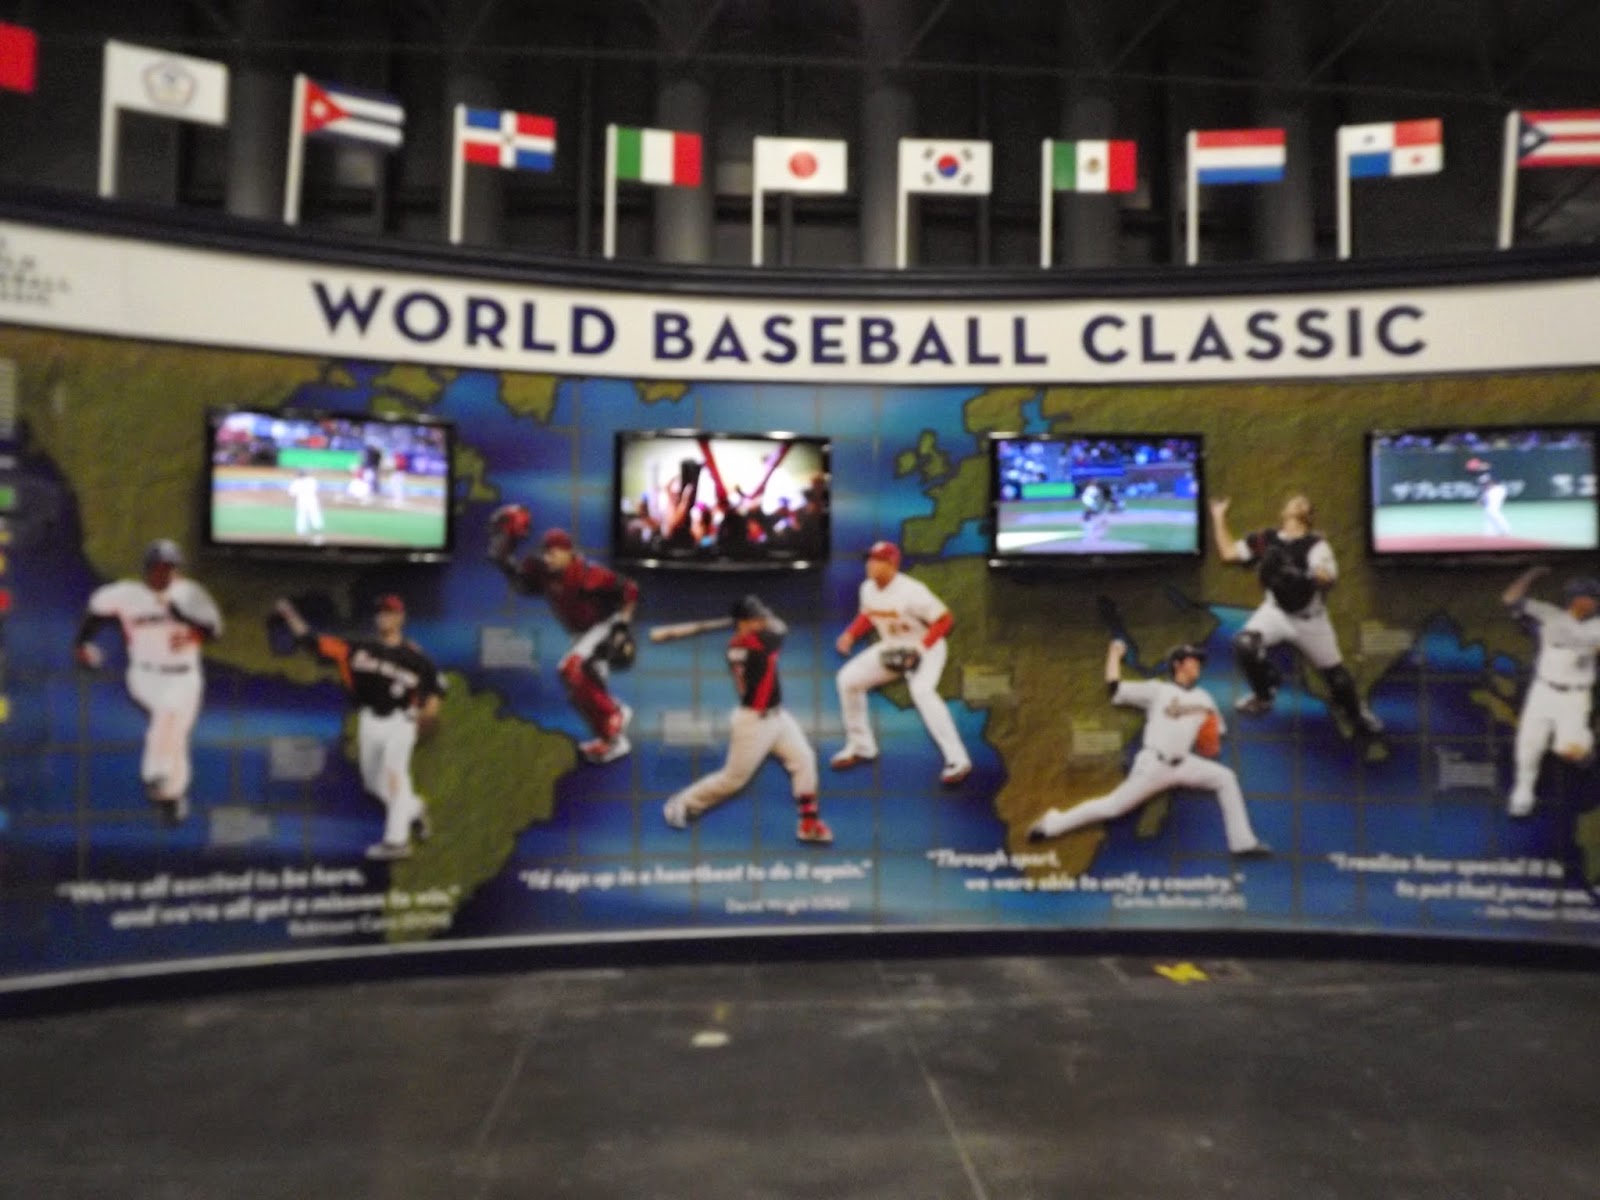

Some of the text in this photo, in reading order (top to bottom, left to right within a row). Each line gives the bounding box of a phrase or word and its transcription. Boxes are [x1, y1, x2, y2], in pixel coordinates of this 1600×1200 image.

[311, 280, 1427, 366] WORLD BASEBALL CLASSIC
[1079, 873, 1098, 892] to
